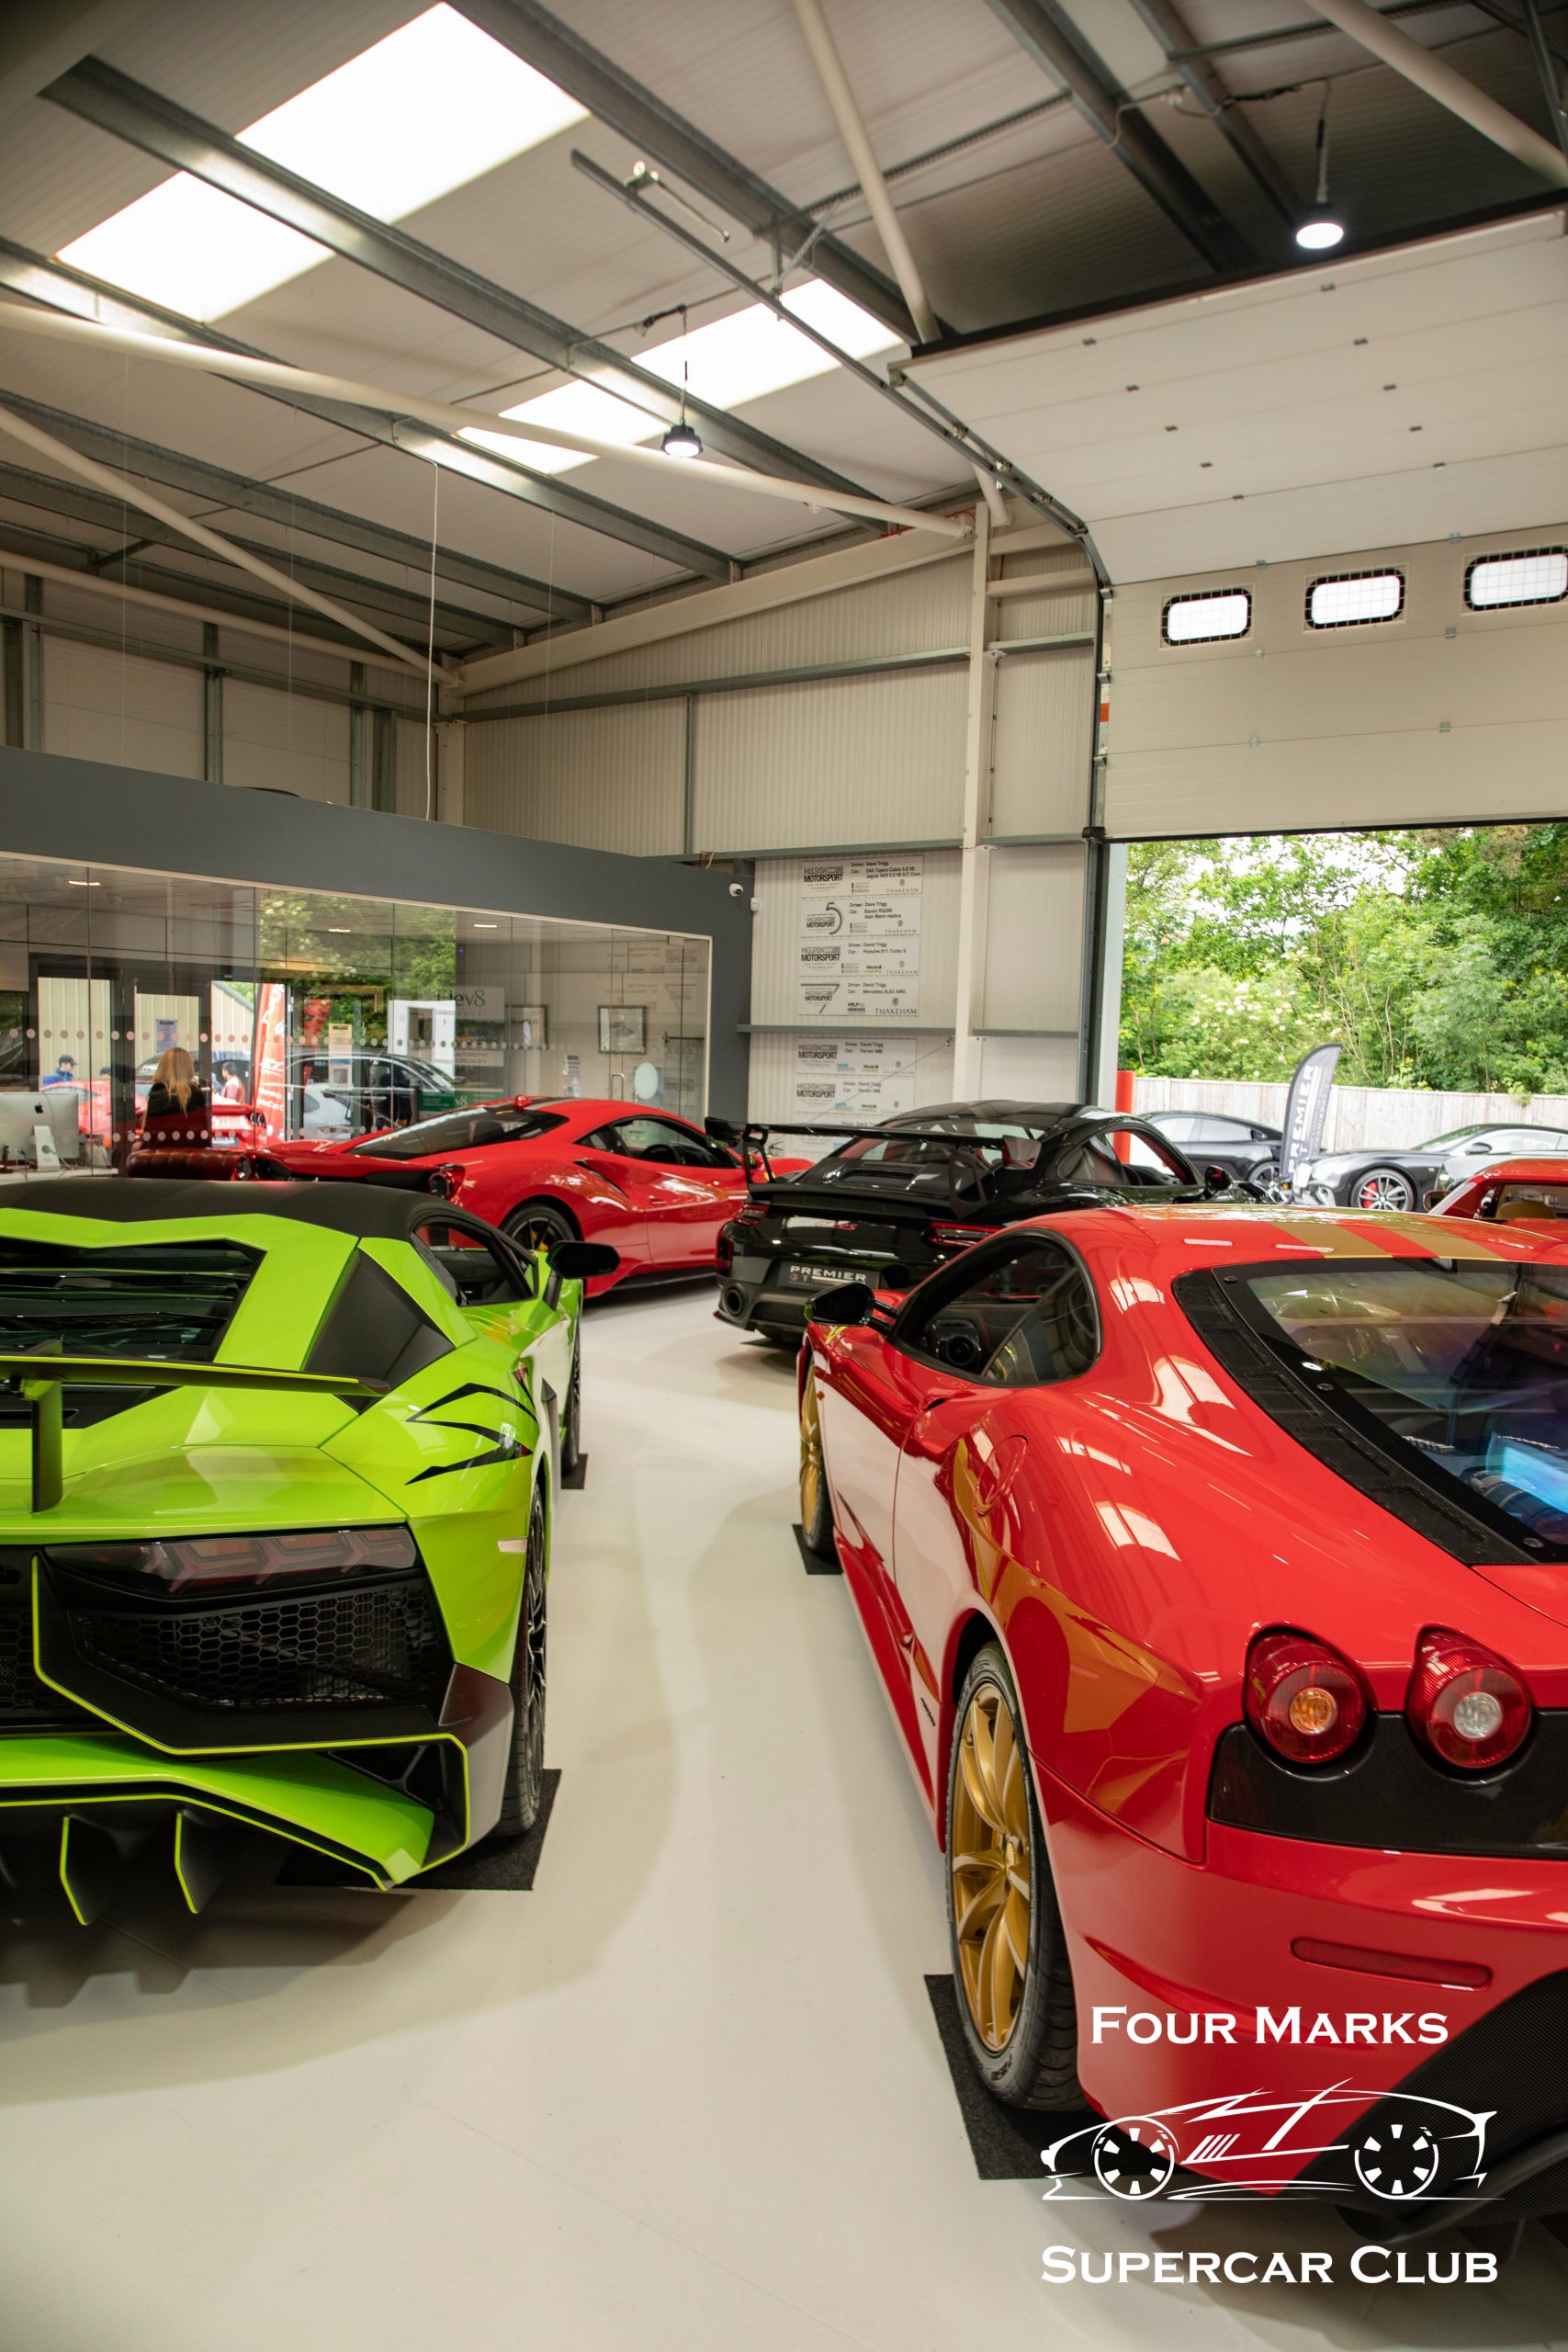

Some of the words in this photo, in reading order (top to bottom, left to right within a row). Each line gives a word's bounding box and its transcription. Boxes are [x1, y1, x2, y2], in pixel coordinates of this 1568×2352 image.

[804, 874, 843, 882] MOTORSPORT
[796, 1090, 835, 1098] MOTORSPORT
[1288, 1065, 1314, 1173] PREMIER
[790, 1265, 867, 1283] PREMIER
